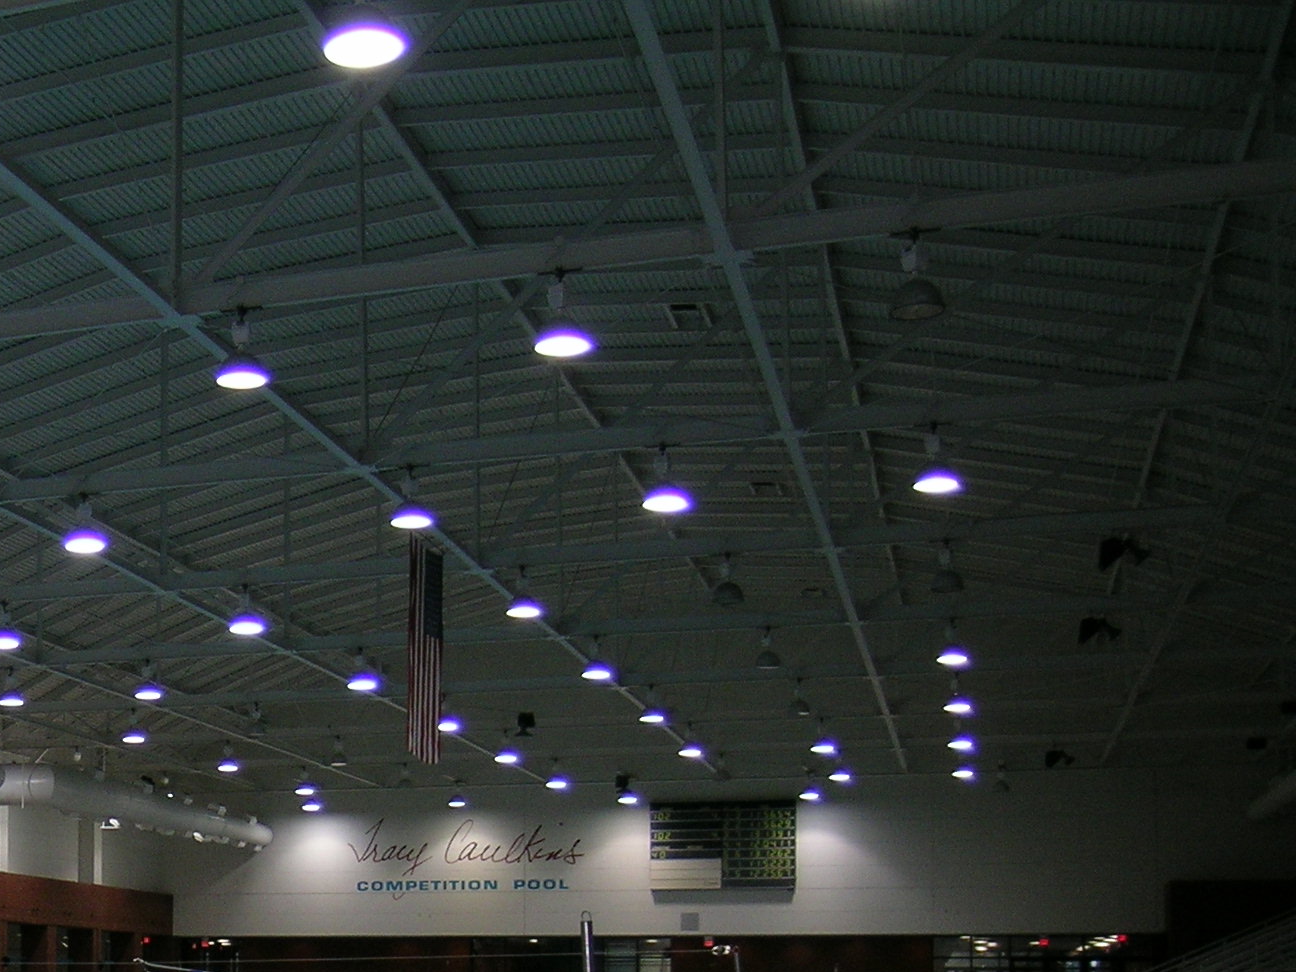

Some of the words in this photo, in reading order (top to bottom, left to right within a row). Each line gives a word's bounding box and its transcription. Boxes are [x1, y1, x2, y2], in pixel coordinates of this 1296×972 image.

[349, 818, 433, 899] Tracy
[444, 819, 585, 865] Caulkins
[356, 879, 498, 892] COMPETITION
[513, 878, 569, 890] POOL
